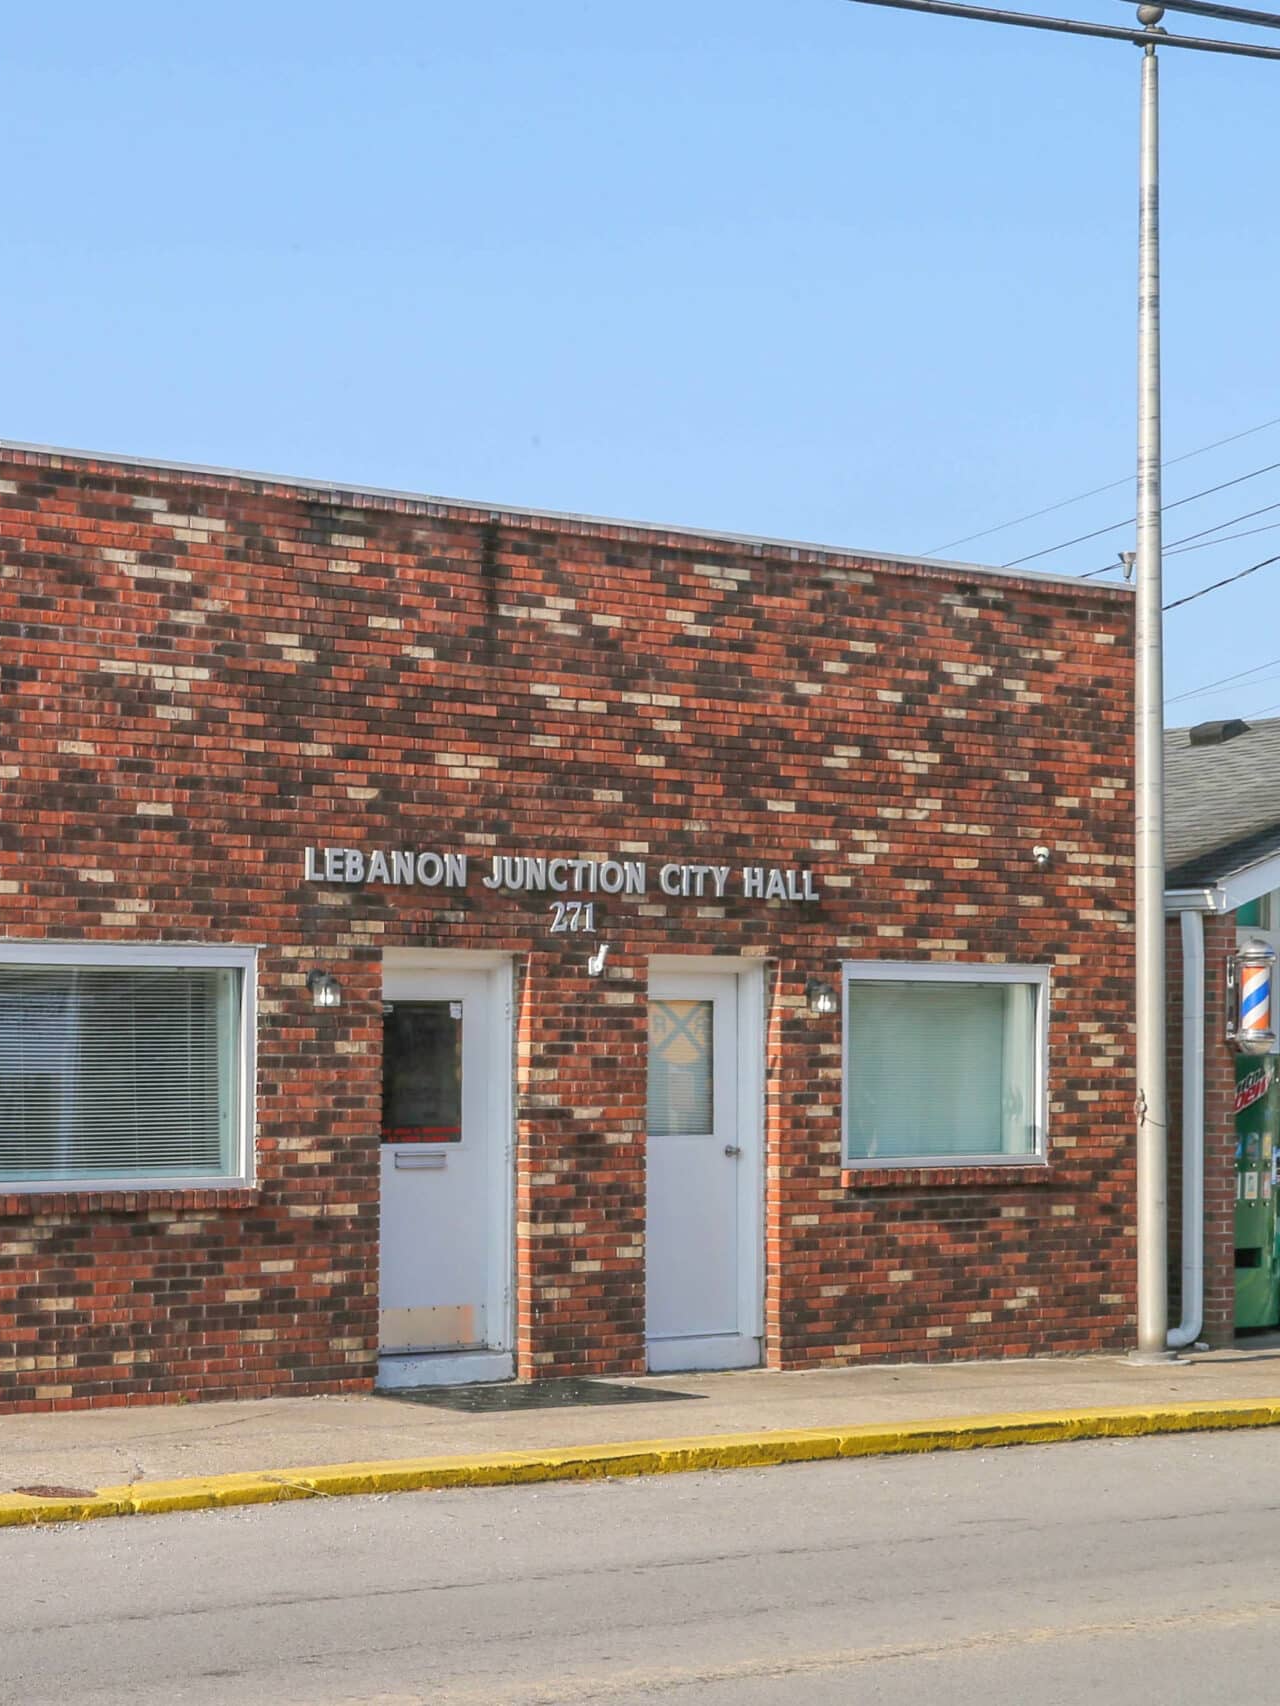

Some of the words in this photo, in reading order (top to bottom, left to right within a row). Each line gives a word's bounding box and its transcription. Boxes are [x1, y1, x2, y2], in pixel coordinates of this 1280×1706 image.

[304, 846, 467, 888] LEBANON
[482, 855, 646, 894] JUNCTION
[659, 863, 731, 898] CITY
[743, 867, 820, 901] HALL
[549, 901, 597, 934] 271
